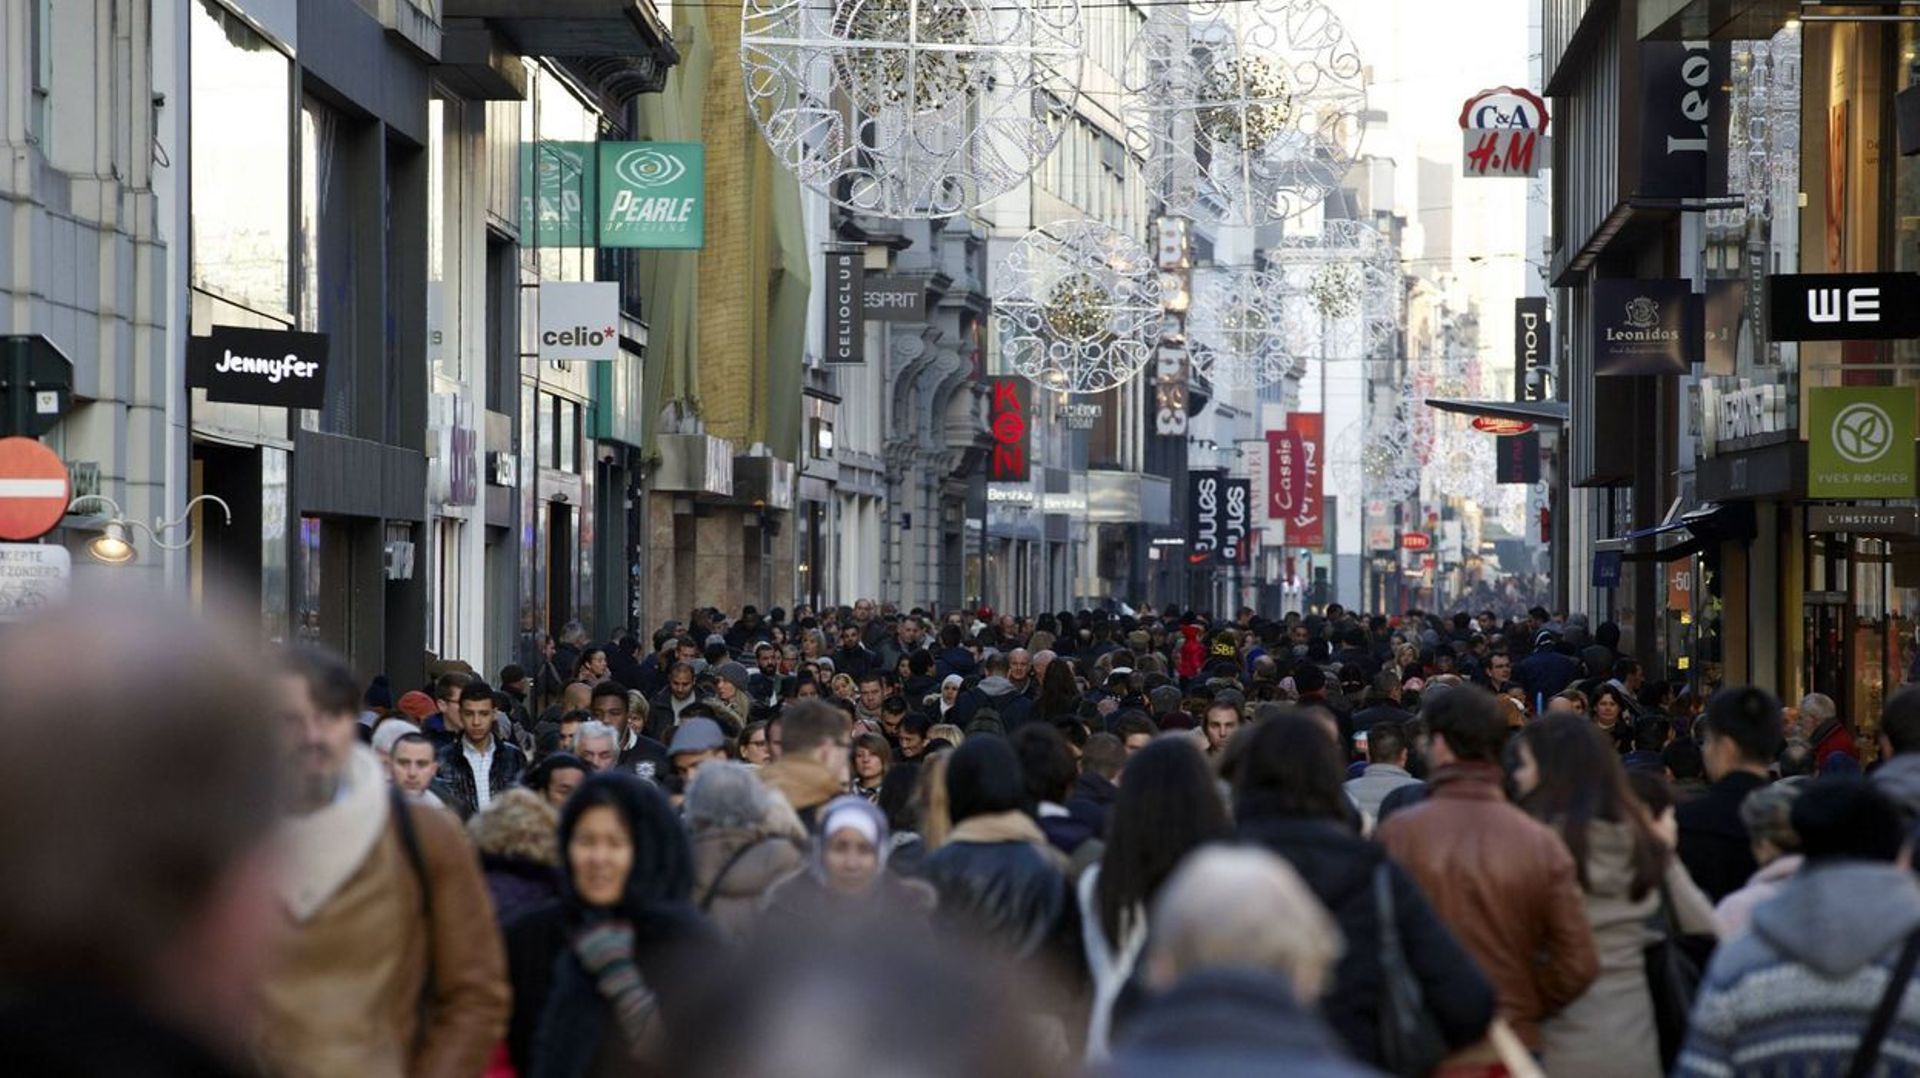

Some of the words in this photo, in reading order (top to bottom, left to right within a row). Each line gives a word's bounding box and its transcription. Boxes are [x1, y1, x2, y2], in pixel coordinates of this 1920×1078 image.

[1667, 40, 1709, 154] Leo
[1475, 104, 1531, 129] C&A
[609, 190, 696, 223] PEARLE
[838, 255, 851, 358] CELIOCLUB
[863, 292, 918, 308] ESPRIT
[1808, 288, 1880, 322] WE
[1606, 327, 1680, 341] Leonidas
[215, 349, 319, 383] Jennyfer
[1274, 439, 1292, 510] Cassis
[1817, 473, 1850, 483] YVES
[1853, 473, 1909, 484] ROCHER
[1828, 515, 1896, 525] L'INSTITUT
